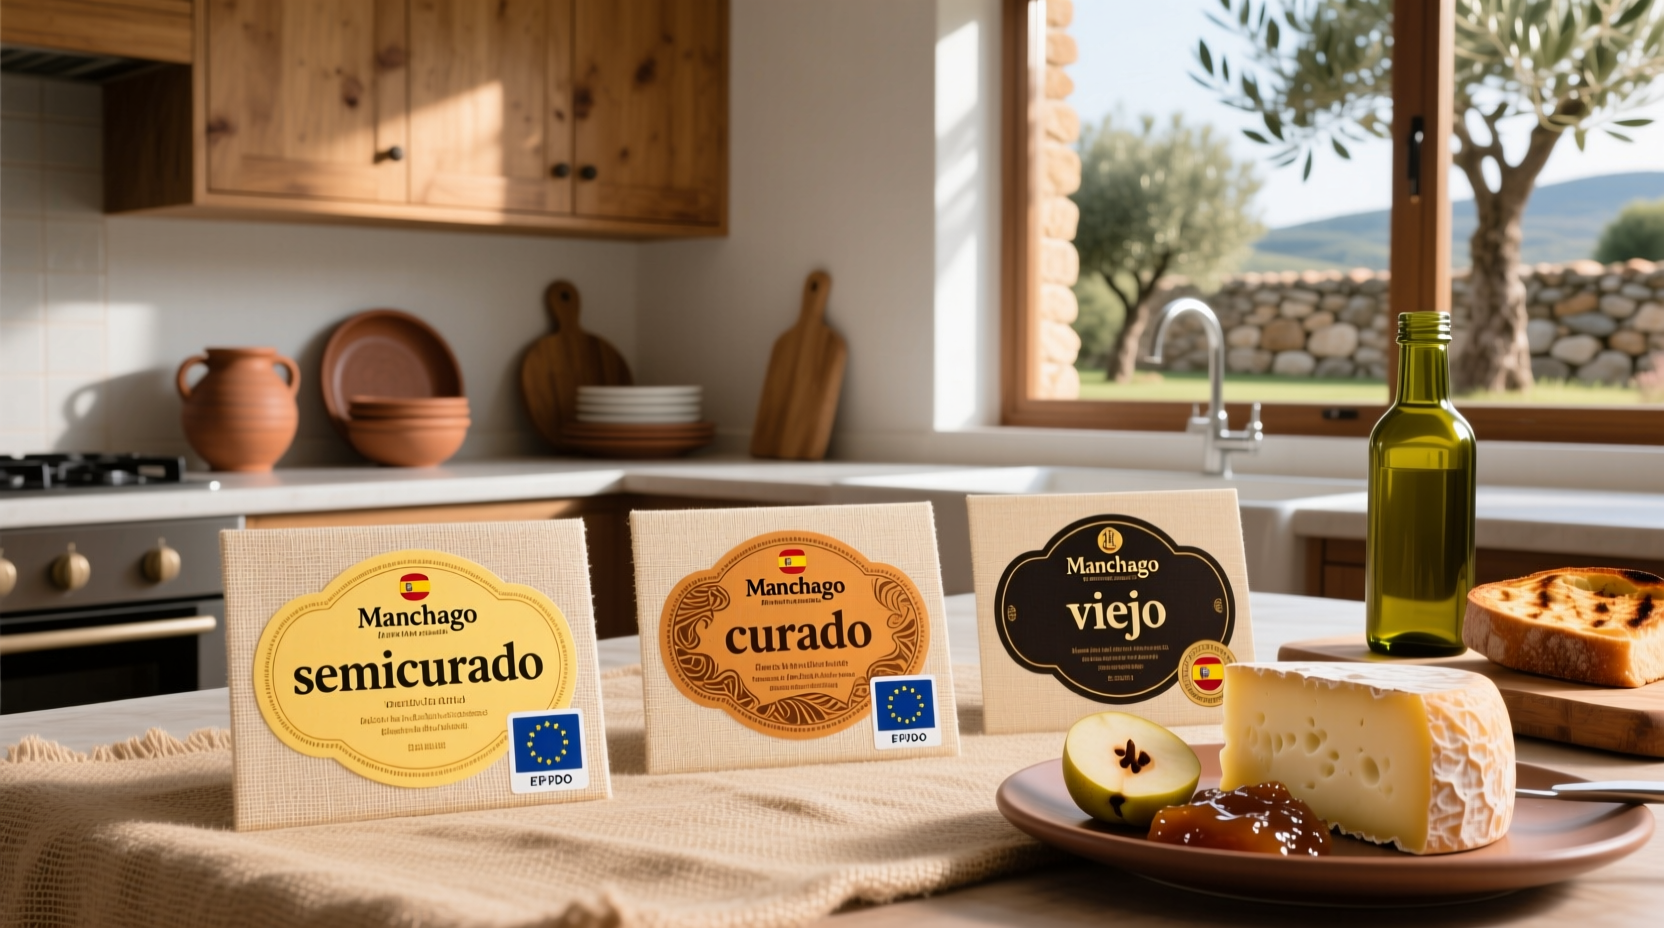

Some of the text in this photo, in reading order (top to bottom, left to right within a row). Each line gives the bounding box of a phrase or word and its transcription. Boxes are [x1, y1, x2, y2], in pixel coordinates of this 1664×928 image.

[1066, 555, 1159, 579] Manchago
[745, 576, 846, 601] Manchago
[358, 603, 478, 631] Manchago
[726, 609, 872, 655] curado
[1066, 589, 1167, 641] viejo
[293, 641, 544, 695] semicurado
